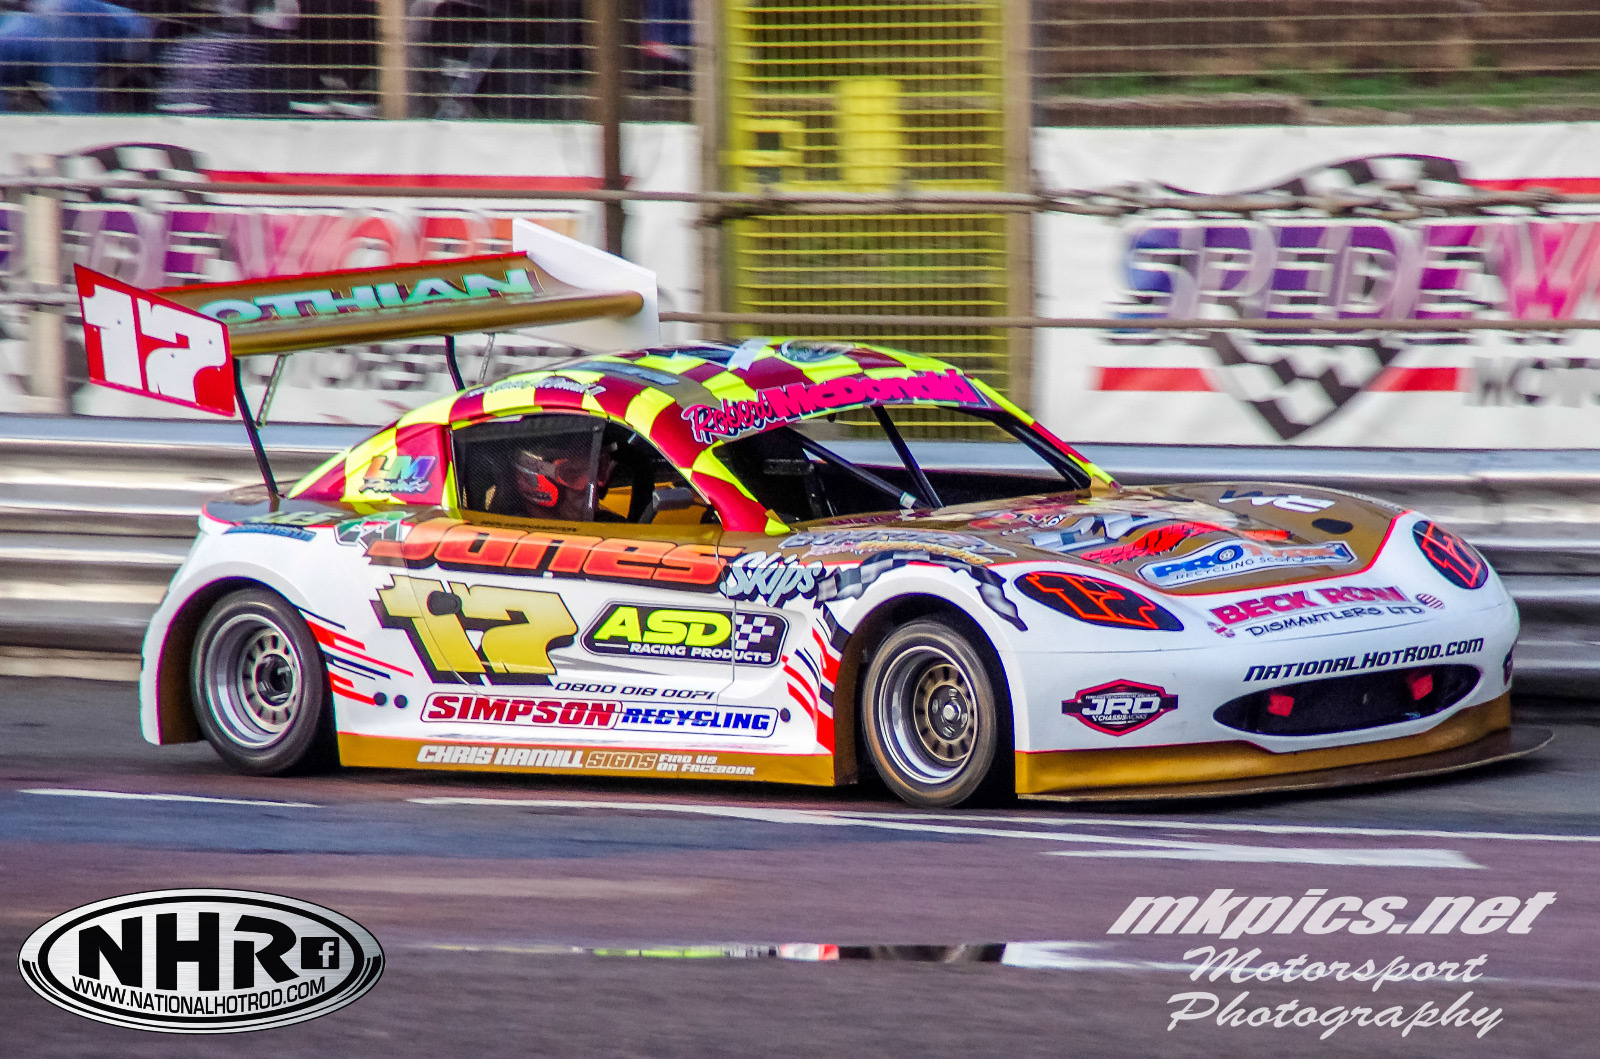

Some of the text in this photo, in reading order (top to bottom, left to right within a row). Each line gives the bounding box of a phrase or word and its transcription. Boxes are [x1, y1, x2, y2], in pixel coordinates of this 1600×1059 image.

[83, 284, 230, 404] 17
[682, 369, 980, 443] Robert McDonald
[368, 518, 745, 588] Jones
[718, 550, 827, 608] Skips
[1152, 544, 1244, 578] PRO
[1175, 558, 1255, 580] RECYCLING
[1208, 586, 1407, 626] BECK ROW
[1245, 605, 1427, 637] DISMANTLERS LTD
[371, 573, 579, 686] 17
[593, 606, 732, 647] ASD
[629, 642, 772, 663] RACING PRODUCTS
[554, 681, 616, 694] 0800
[427, 694, 772, 731] SIMPSON RECYCLING
[1081, 696, 1161, 716] JRD
[416, 744, 658, 770] CHRIS HAMILL SIGNS
